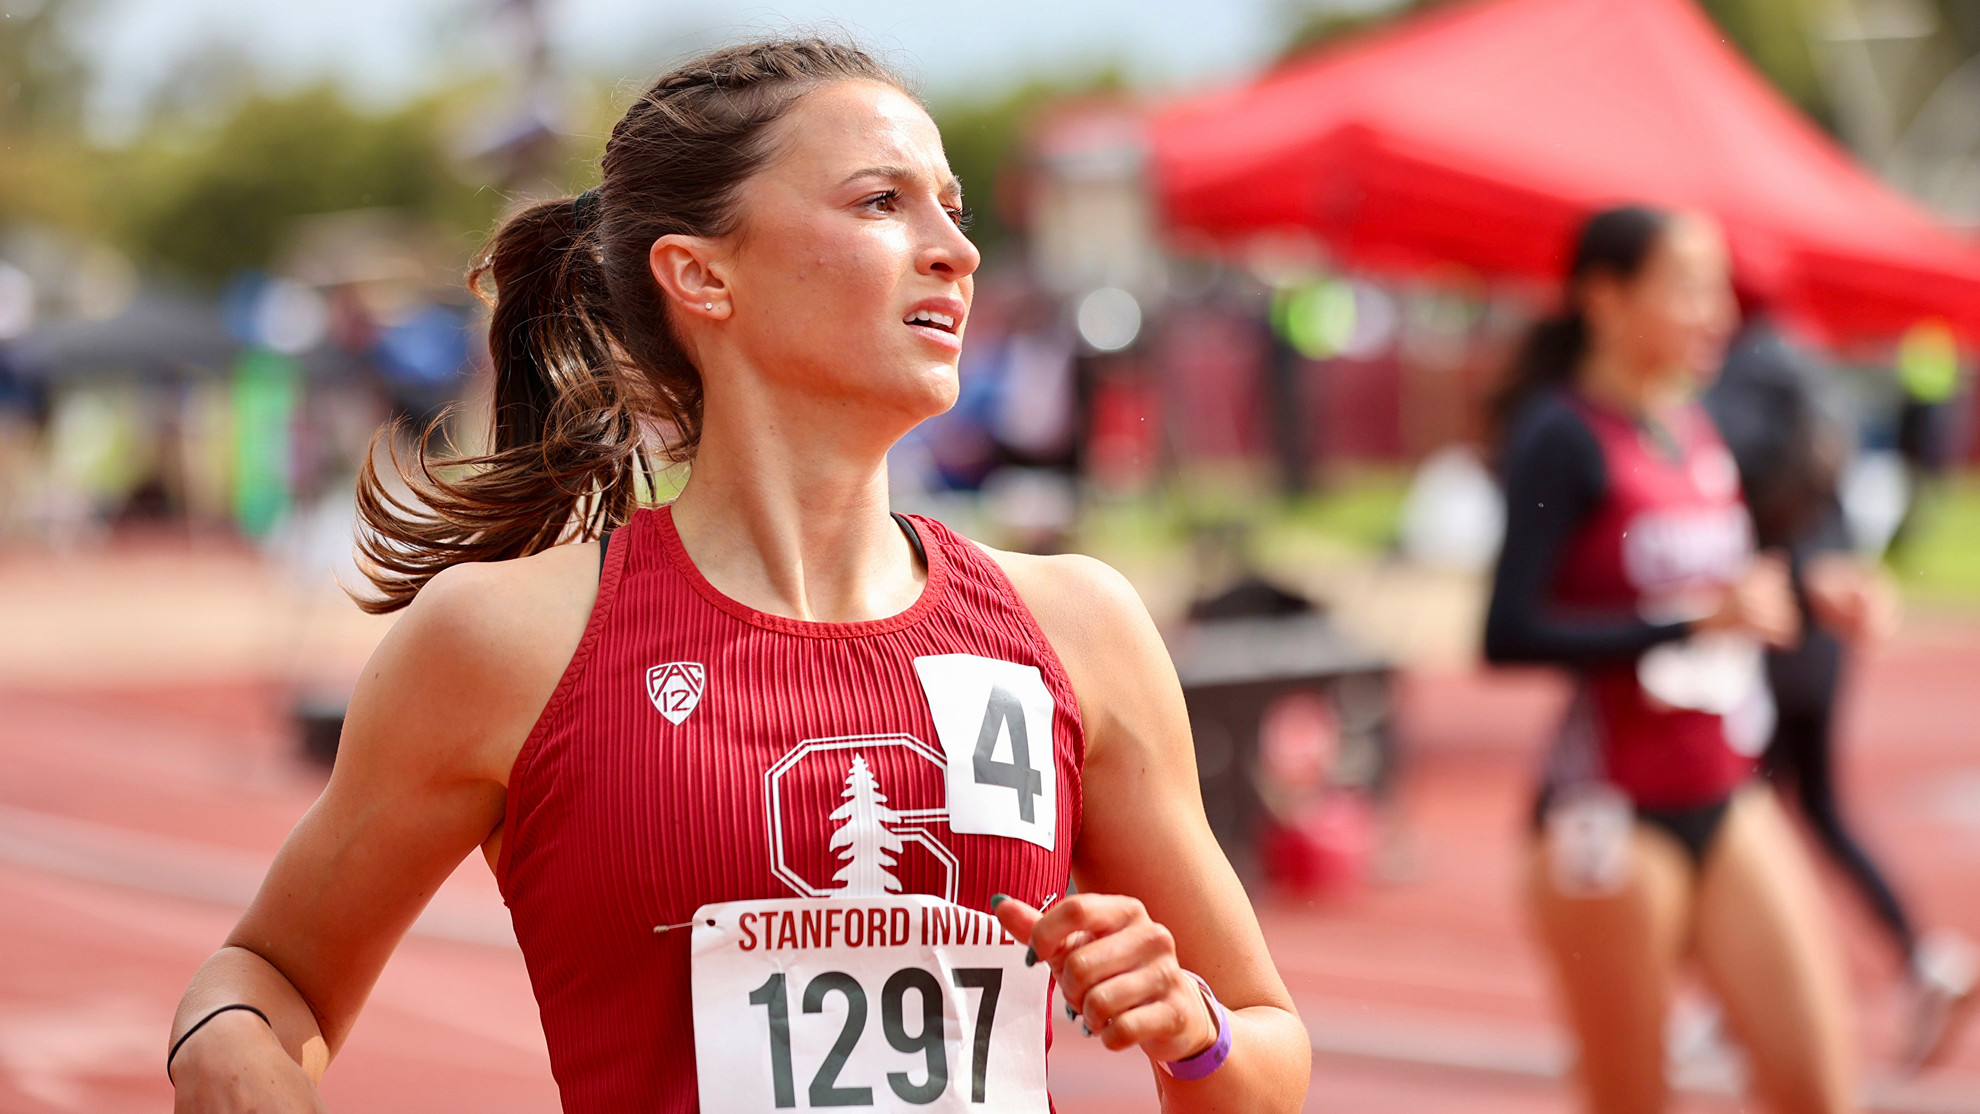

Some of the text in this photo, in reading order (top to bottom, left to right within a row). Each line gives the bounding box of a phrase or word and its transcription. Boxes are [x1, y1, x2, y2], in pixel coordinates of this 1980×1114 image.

[649, 664, 702, 701] PAC
[662, 689, 691, 713] 12
[972, 684, 1043, 825] 4
[738, 907, 911, 951] STANFORD
[748, 966, 1004, 1109] 1297
